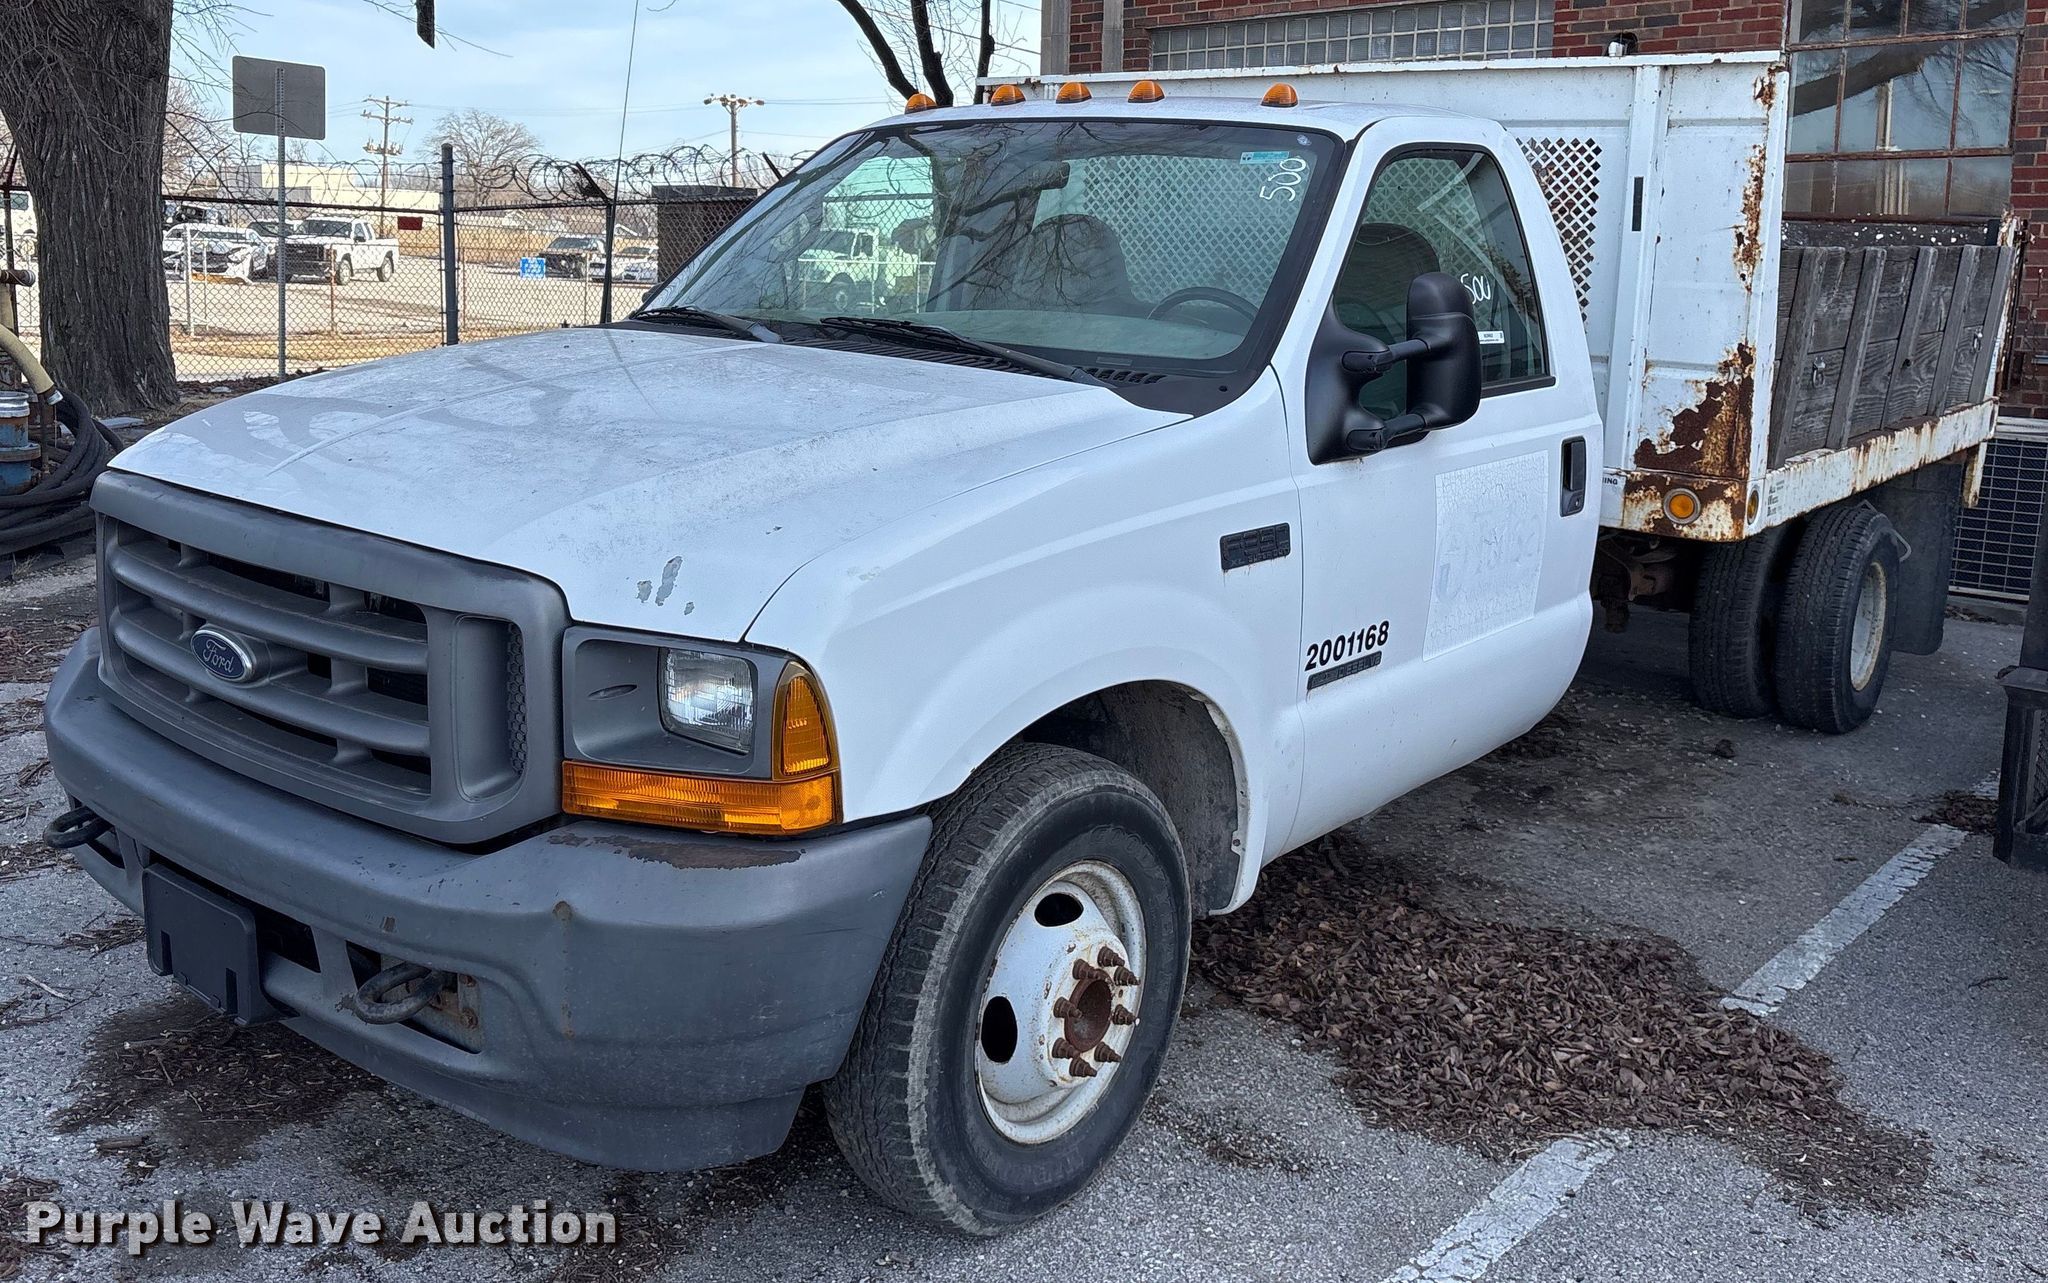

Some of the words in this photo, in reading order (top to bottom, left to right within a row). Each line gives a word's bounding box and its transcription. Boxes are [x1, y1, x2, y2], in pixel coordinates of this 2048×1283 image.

[1259, 157, 1306, 201] 500
[202, 639, 235, 673] Ford
[1305, 620, 1389, 671] 2001168
